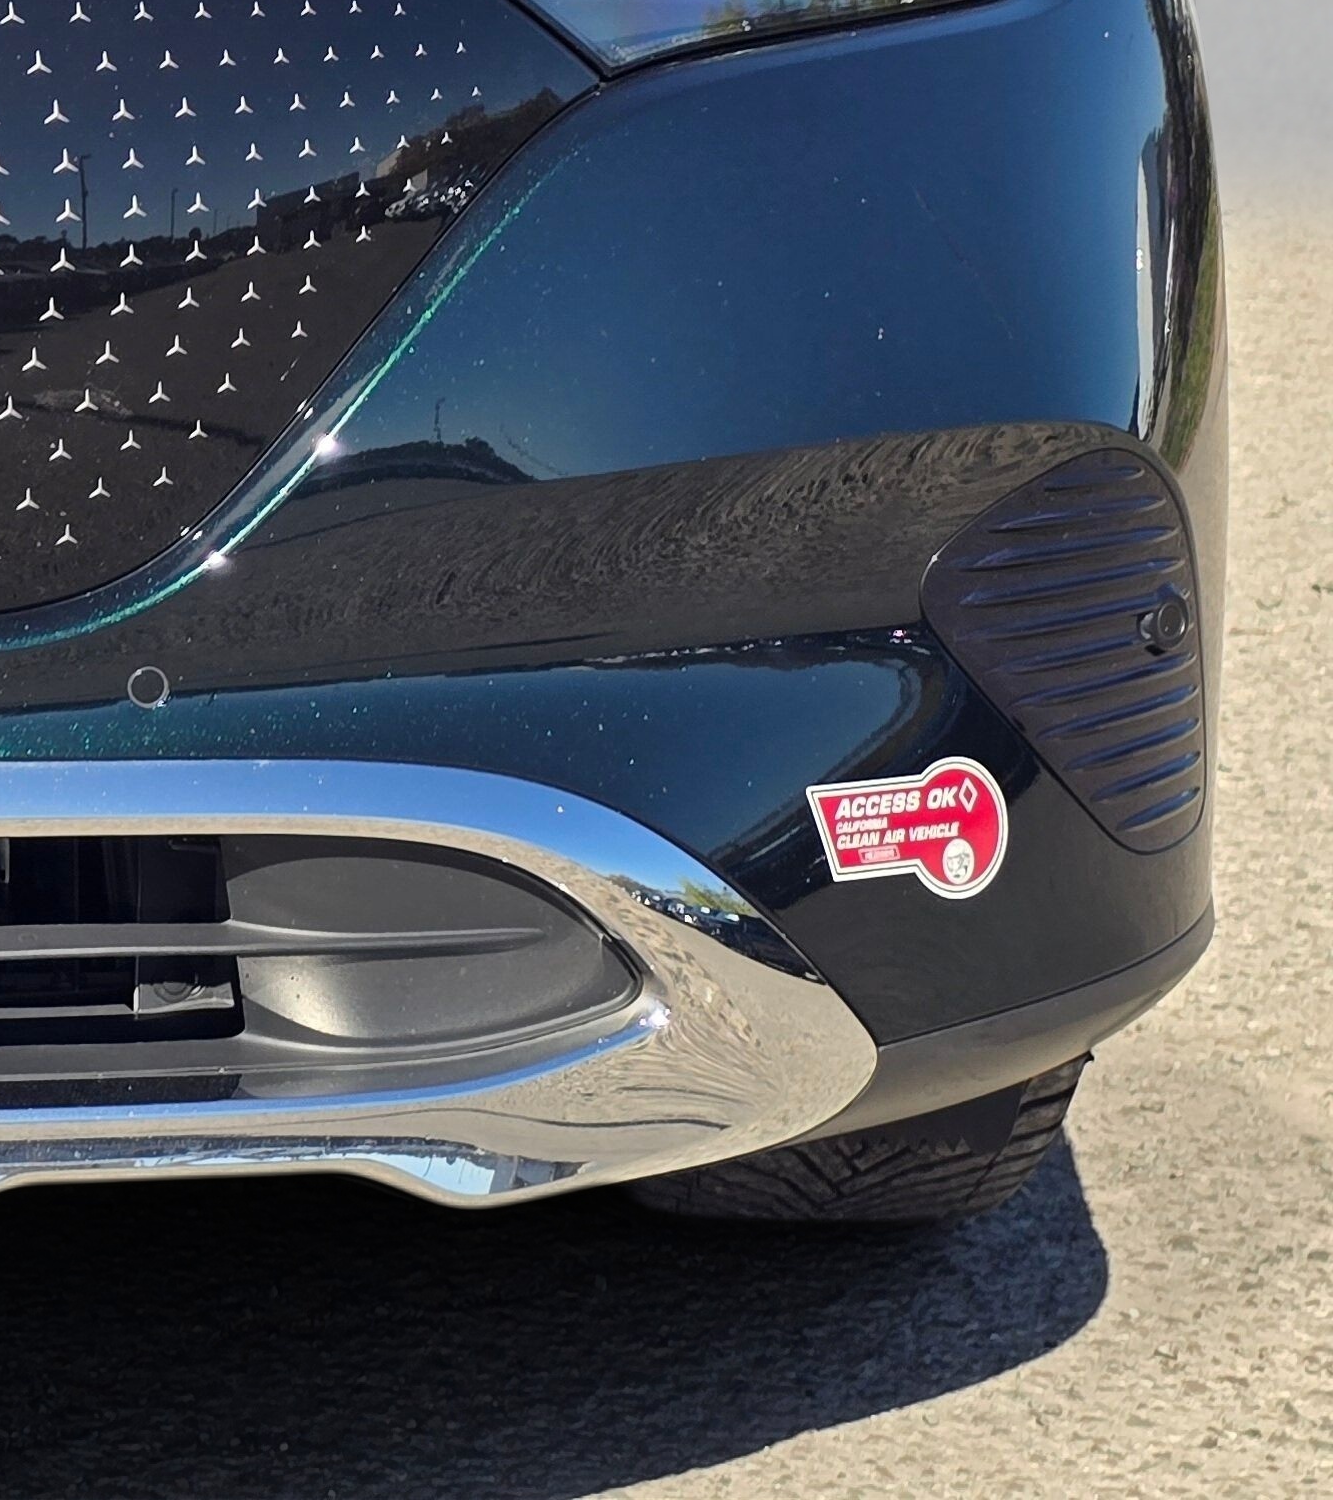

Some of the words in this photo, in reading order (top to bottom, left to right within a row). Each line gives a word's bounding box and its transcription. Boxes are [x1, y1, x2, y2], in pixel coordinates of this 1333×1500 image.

[834, 790, 921, 820] ACCESS
[927, 786, 959, 810] OK
[836, 831, 881, 850] CLEAN
[883, 827, 906, 845] AIR
[909, 821, 961, 844] VEHICLE
